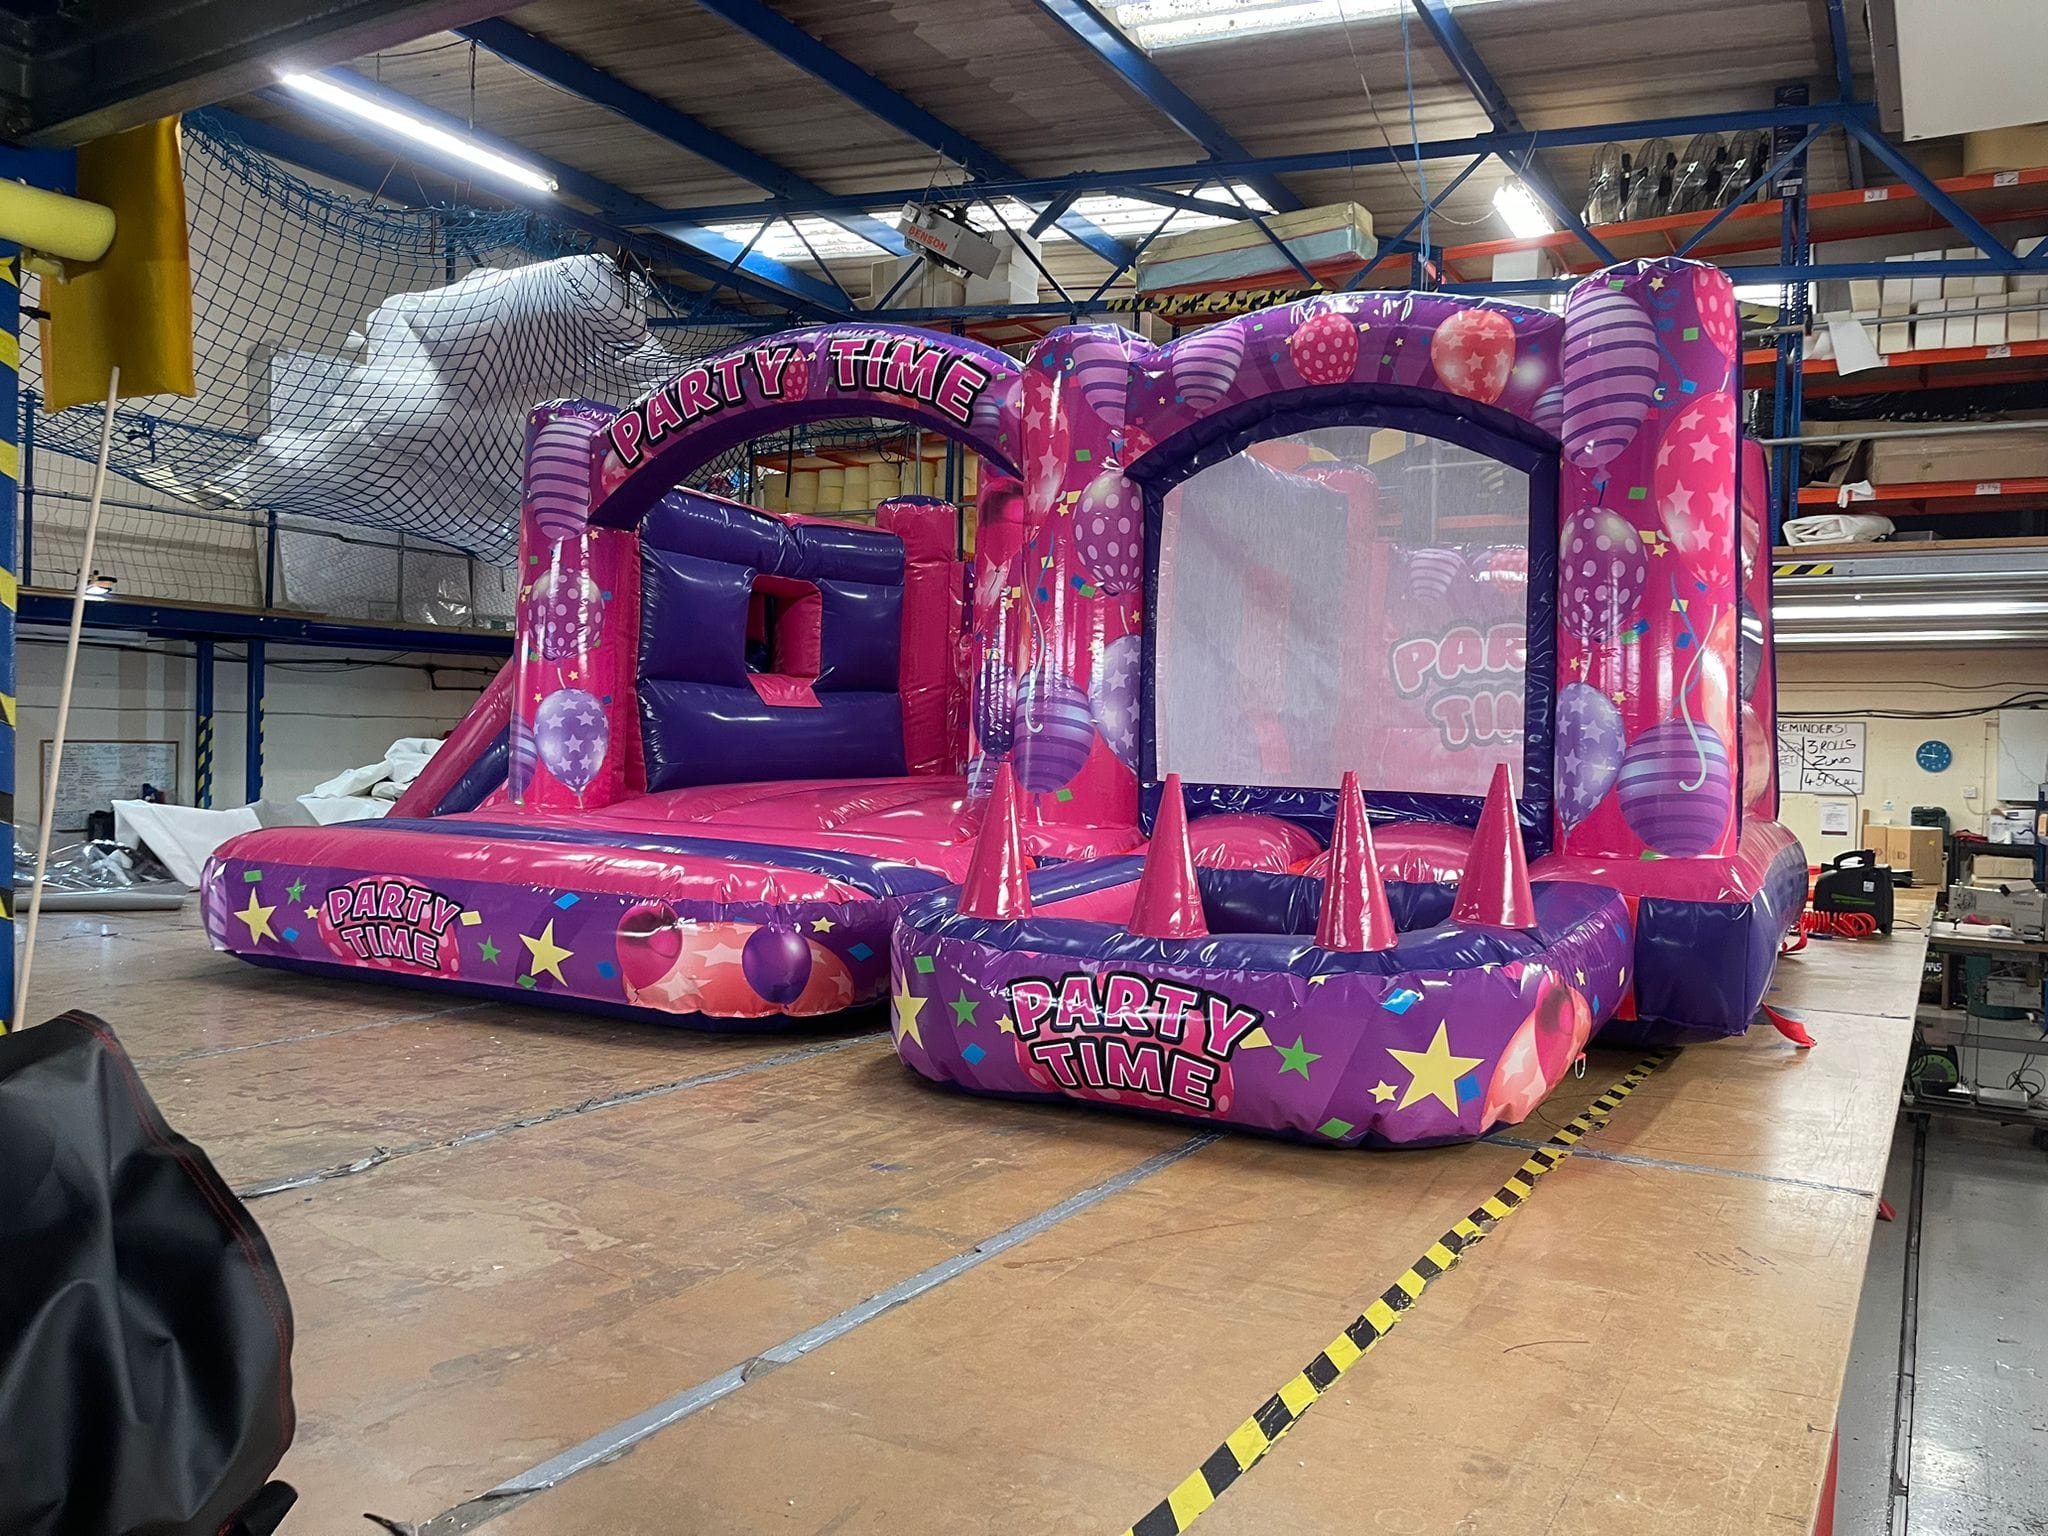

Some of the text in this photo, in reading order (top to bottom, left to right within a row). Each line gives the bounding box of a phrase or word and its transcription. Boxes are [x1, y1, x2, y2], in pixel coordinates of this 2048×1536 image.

[907, 225, 948, 251] BENSON
[609, 339, 987, 464] PARTY TIME
[1807, 740, 1818, 754] 3
[327, 882, 462, 935] PARTY
[340, 925, 439, 969] TIME
[1011, 975, 1257, 1058] PARTY
[1033, 1040, 1216, 1108] TIME
